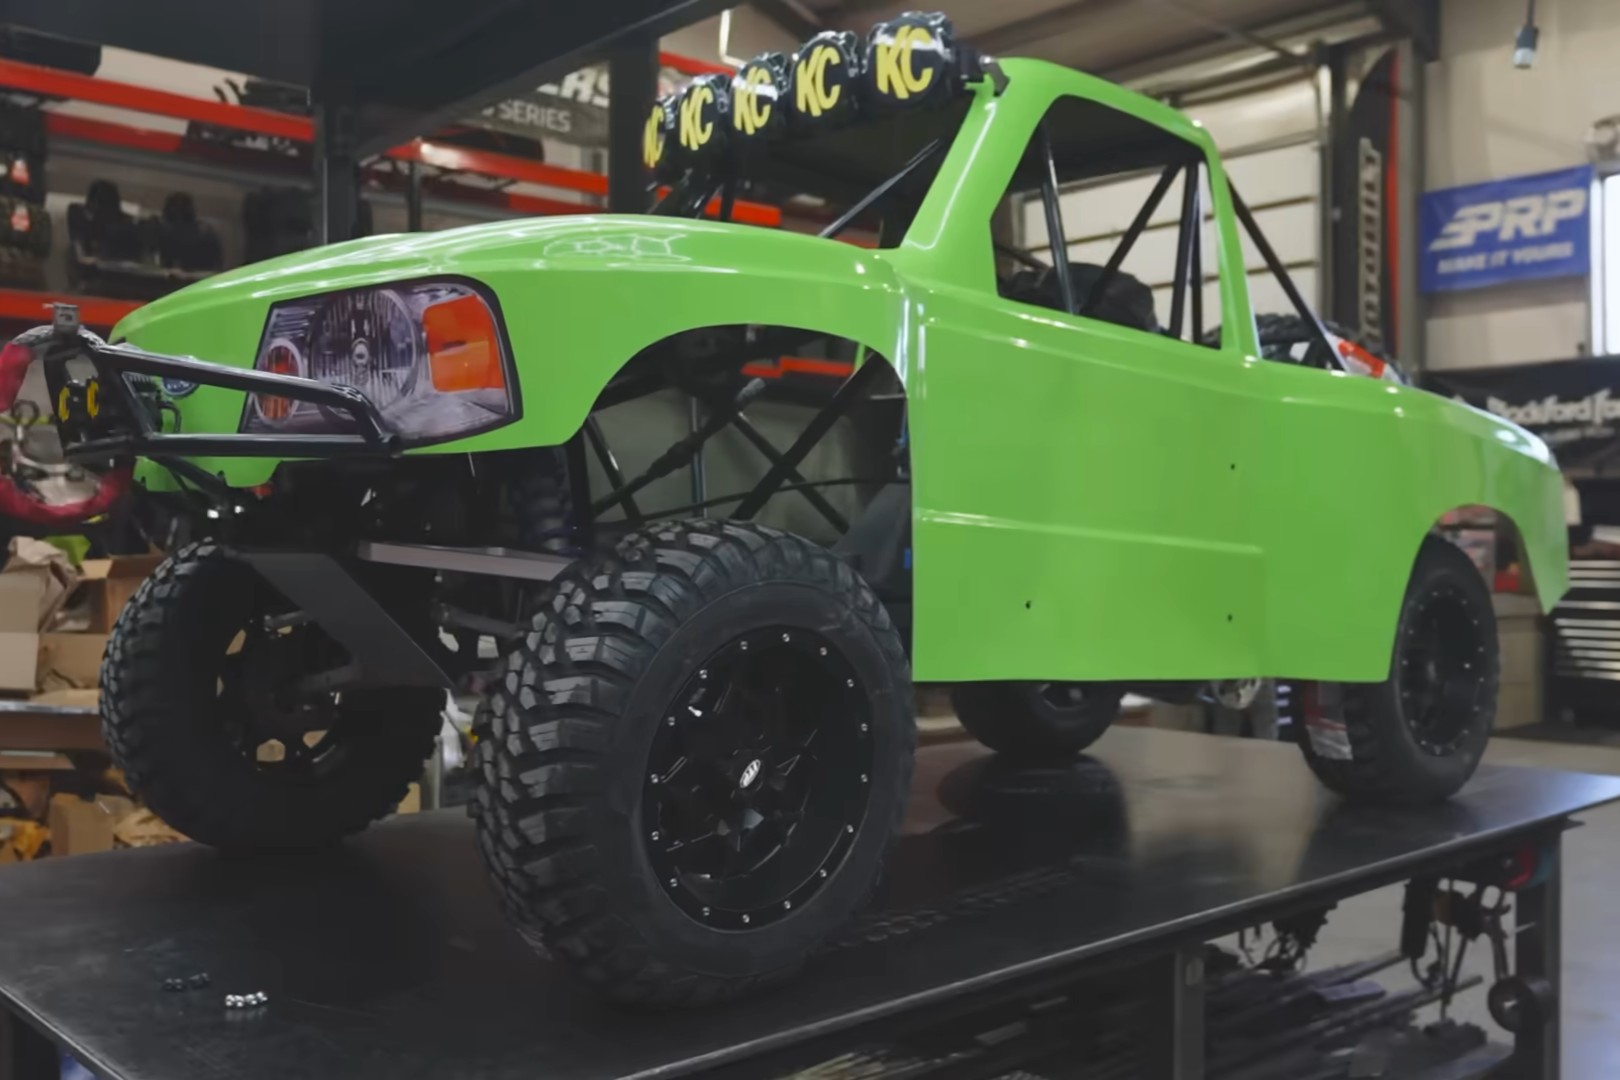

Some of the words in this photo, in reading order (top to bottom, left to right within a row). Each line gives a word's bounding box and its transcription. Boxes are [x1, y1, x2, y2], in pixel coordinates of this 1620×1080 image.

[796, 44, 842, 117] KC
[875, 24, 934, 99] KC
[497, 99, 572, 133] SERIES
[679, 86, 714, 151] KC
[733, 65, 772, 136] KC
[643, 104, 665, 168] KC
[1427, 187, 1587, 252] PRP
